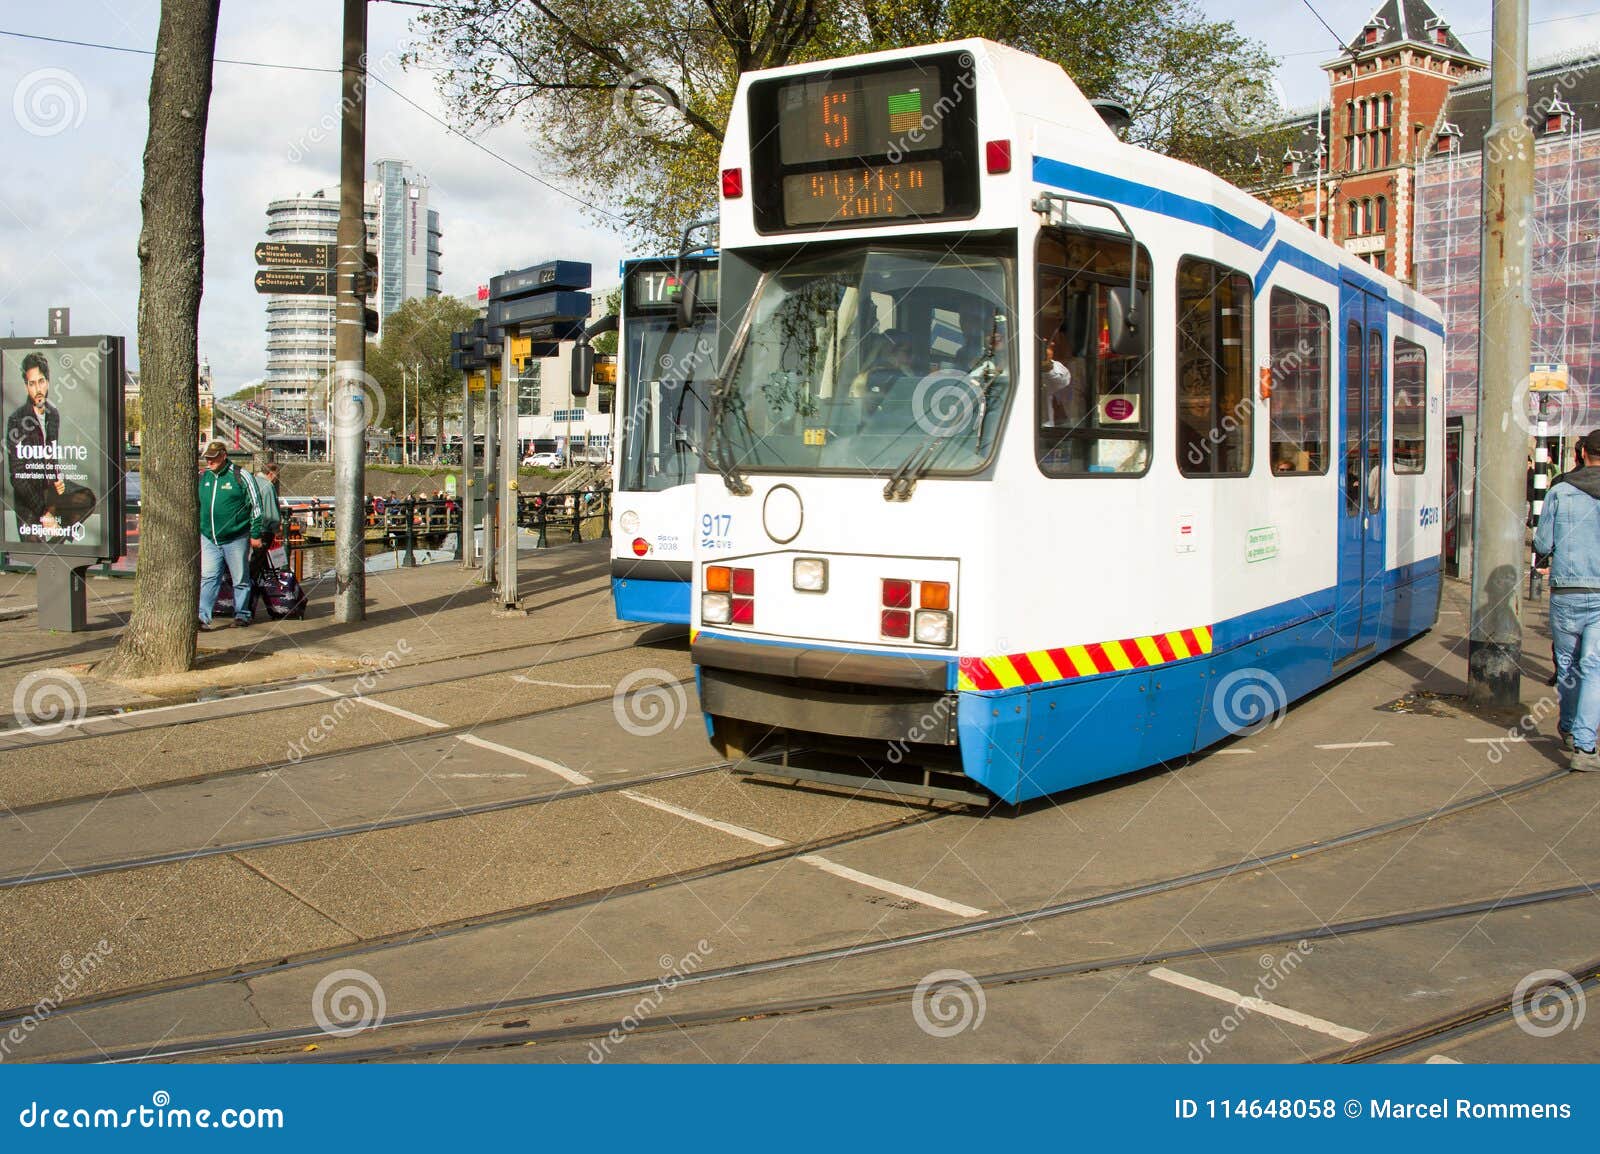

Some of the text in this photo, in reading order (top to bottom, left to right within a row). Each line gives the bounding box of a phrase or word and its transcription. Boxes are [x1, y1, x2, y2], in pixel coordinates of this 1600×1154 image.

[823, 92, 849, 148] 5
[812, 167, 923, 197] Station
[265, 279, 299, 287] Oosterpark
[645, 271, 667, 302] 17
[20, 524, 71, 538] de Bijenkorf
[702, 513, 732, 537] 917
